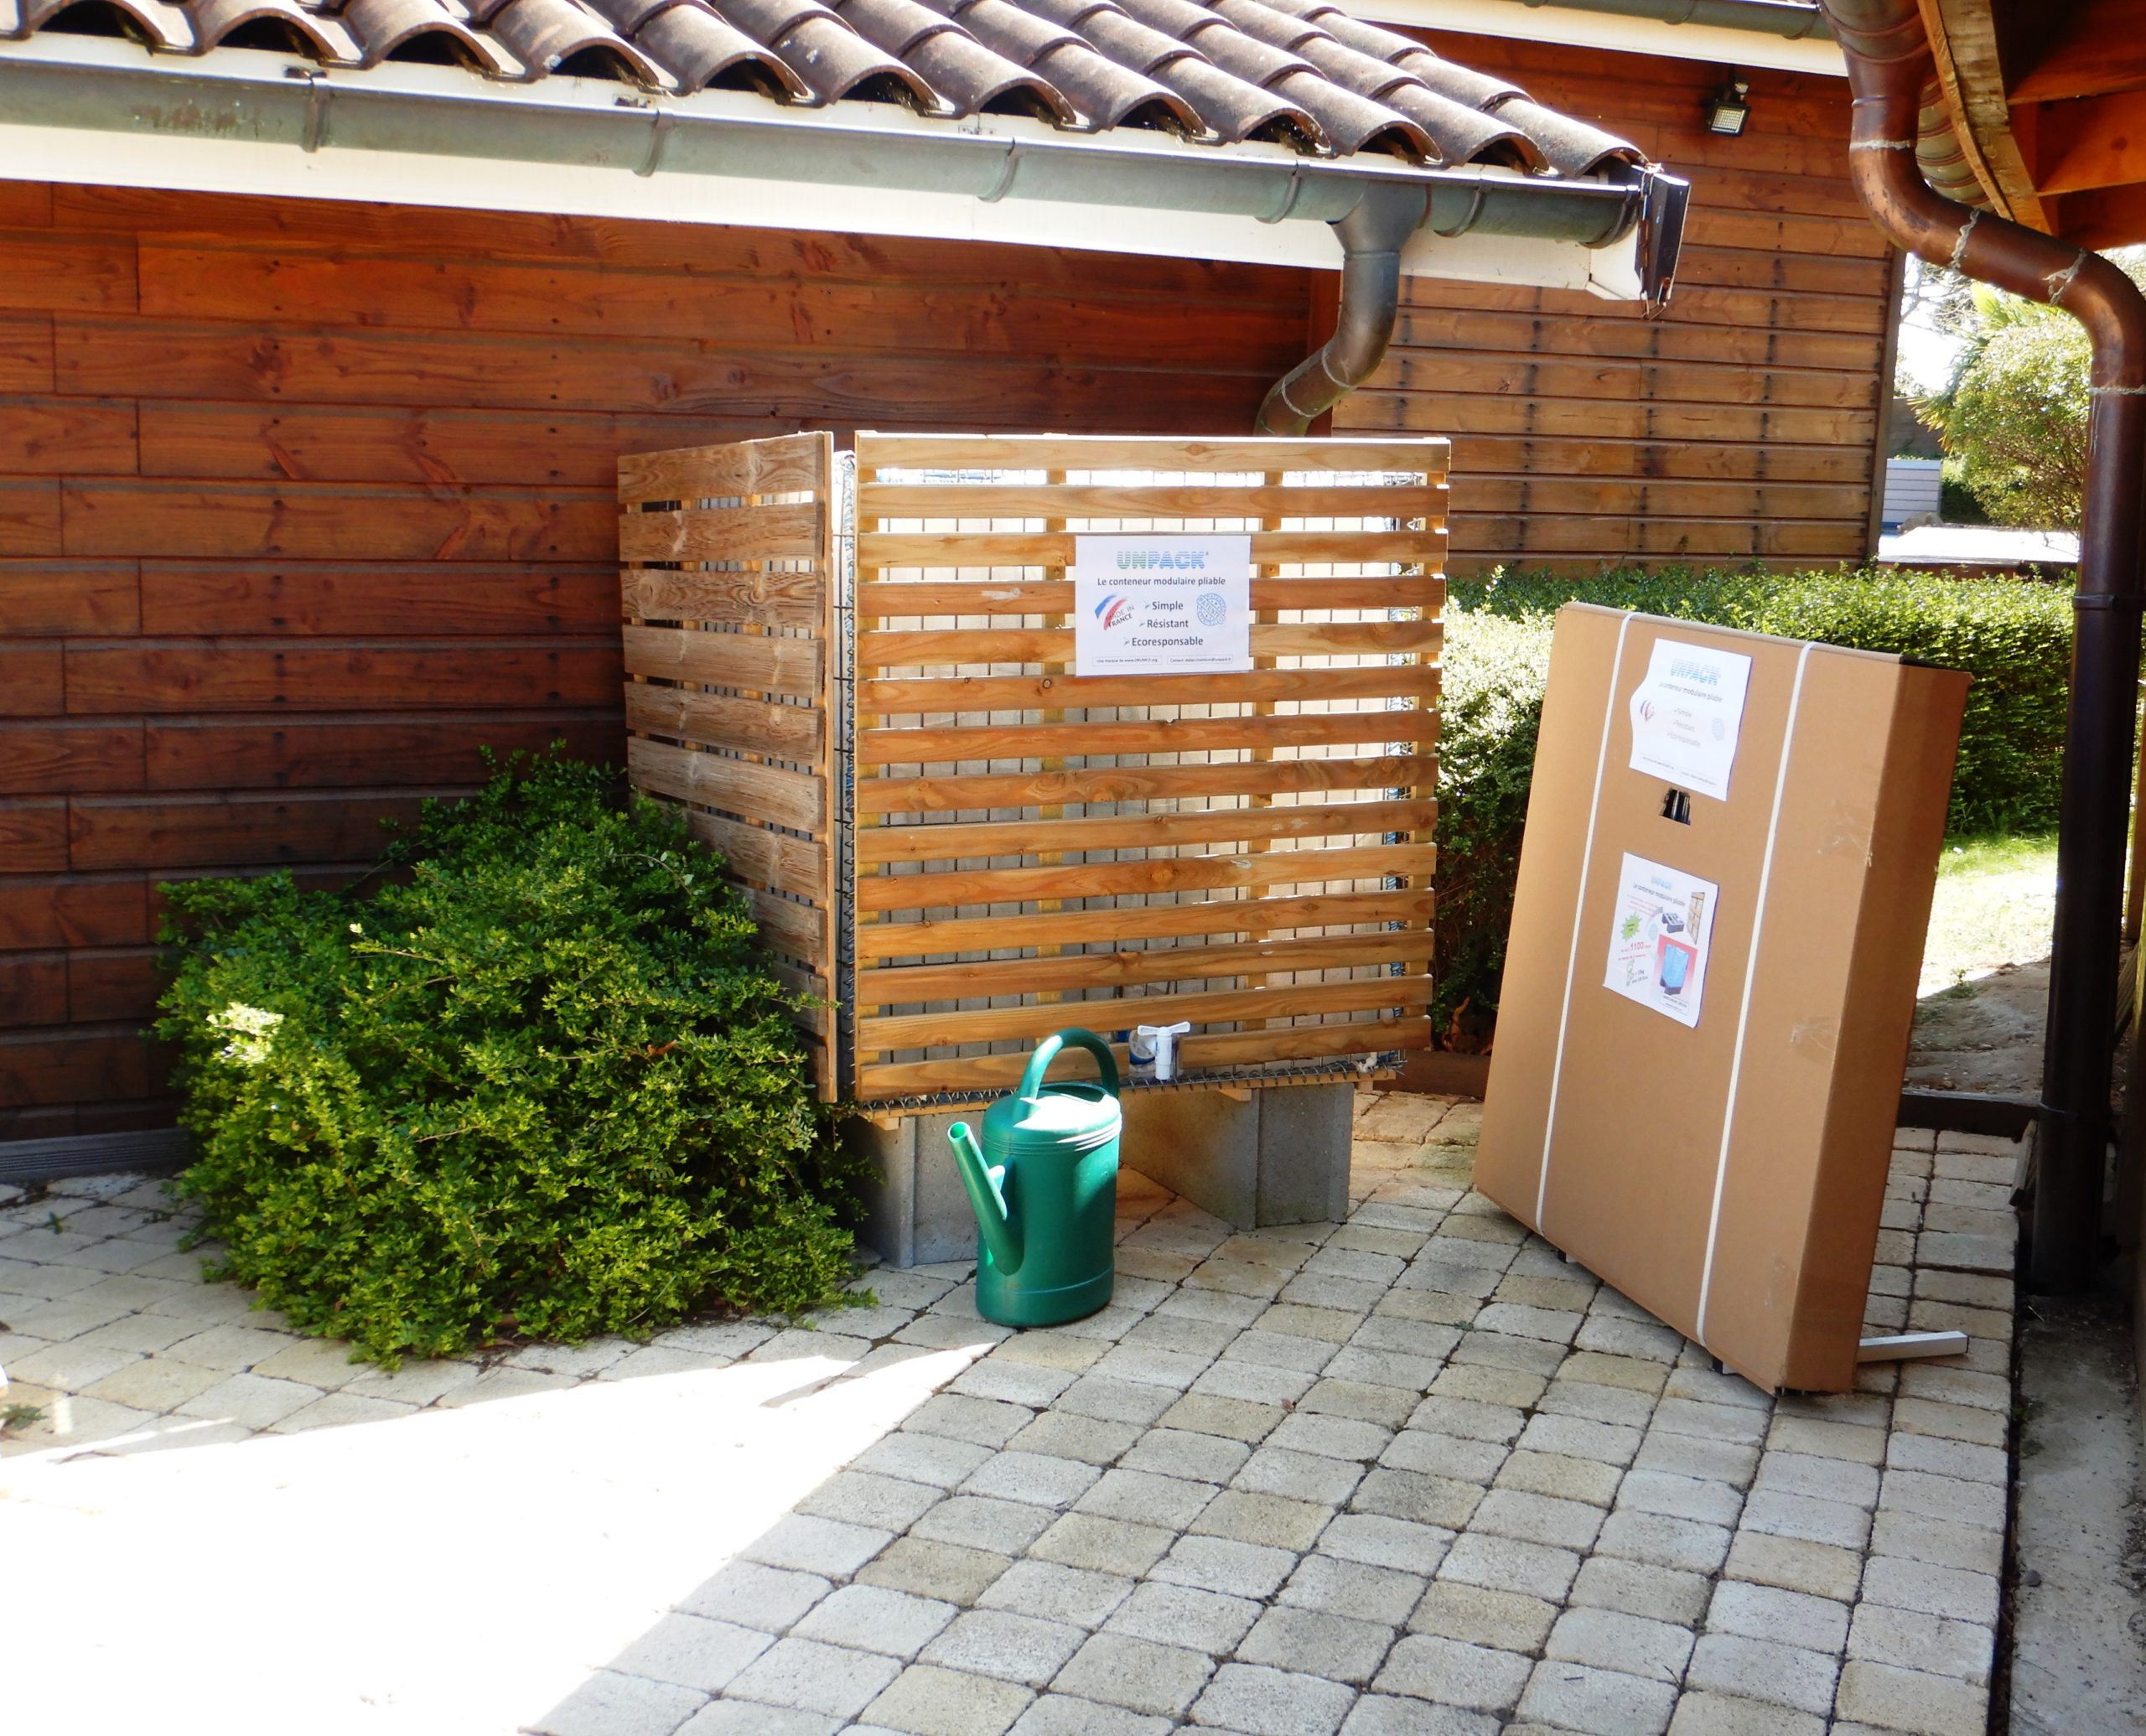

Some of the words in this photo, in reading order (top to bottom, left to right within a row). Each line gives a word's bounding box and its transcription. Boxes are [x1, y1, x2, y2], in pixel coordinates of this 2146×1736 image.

[1117, 551, 1205, 570] UNPACK
[1097, 578, 1107, 586] Le
[1109, 578, 1151, 586] conteneur
[1153, 577, 1195, 586] modulaire
[1198, 577, 1226, 587] pliable
[1127, 604, 1134, 613] IN
[1152, 600, 1184, 613] Simple
[1108, 613, 1133, 629] FRANCE
[1147, 618, 1189, 628] Résistant
[1132, 636, 1204, 648] Ecoresponsable
